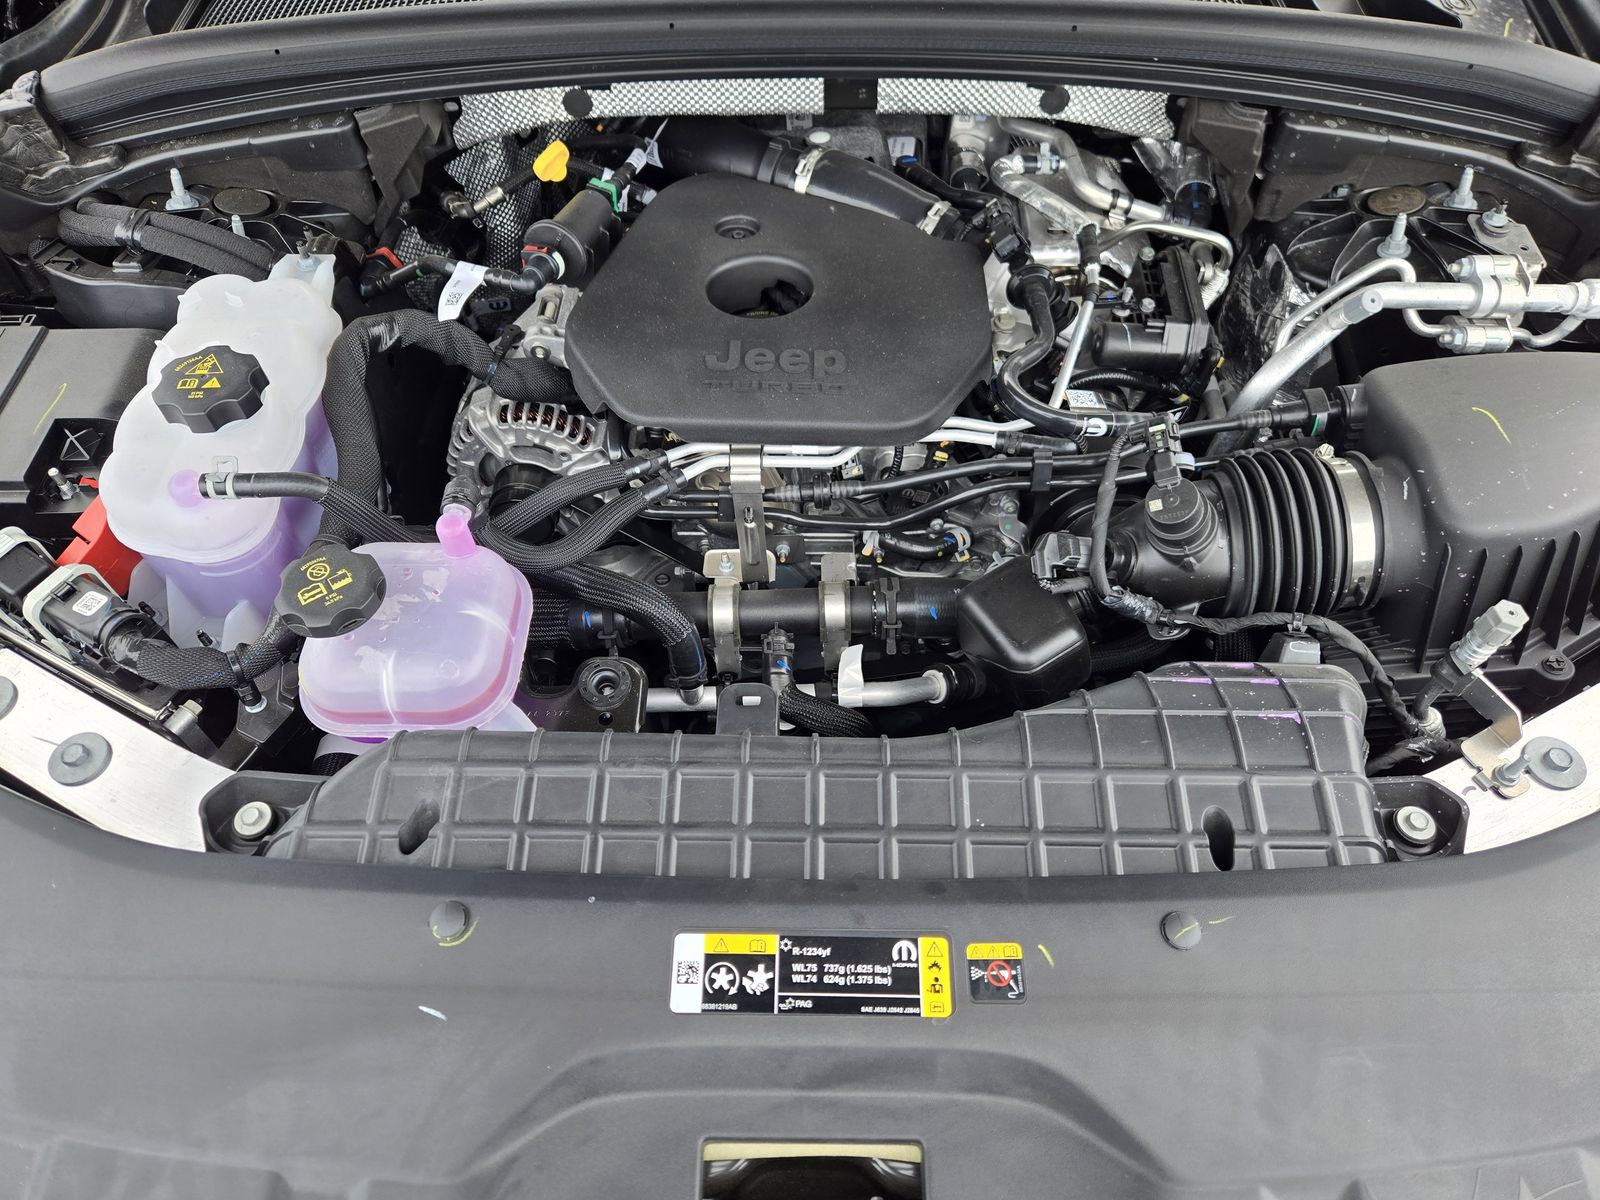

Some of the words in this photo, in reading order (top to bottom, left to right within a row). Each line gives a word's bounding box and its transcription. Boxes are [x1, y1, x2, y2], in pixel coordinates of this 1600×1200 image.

[704, 340, 847, 380] Jeep
[792, 947, 831, 957] R-1234yf
[792, 964, 817, 972] WL75
[823, 964, 845, 974] 737g
[846, 965, 873, 974] (1.625
[874, 965, 892, 975] lbs)
[792, 974, 817, 983] WL74
[823, 975, 845, 985] 624g
[846, 975, 873, 985] (1.375
[874, 976, 892, 986] lbs)
[795, 1000, 813, 1008] PAG
